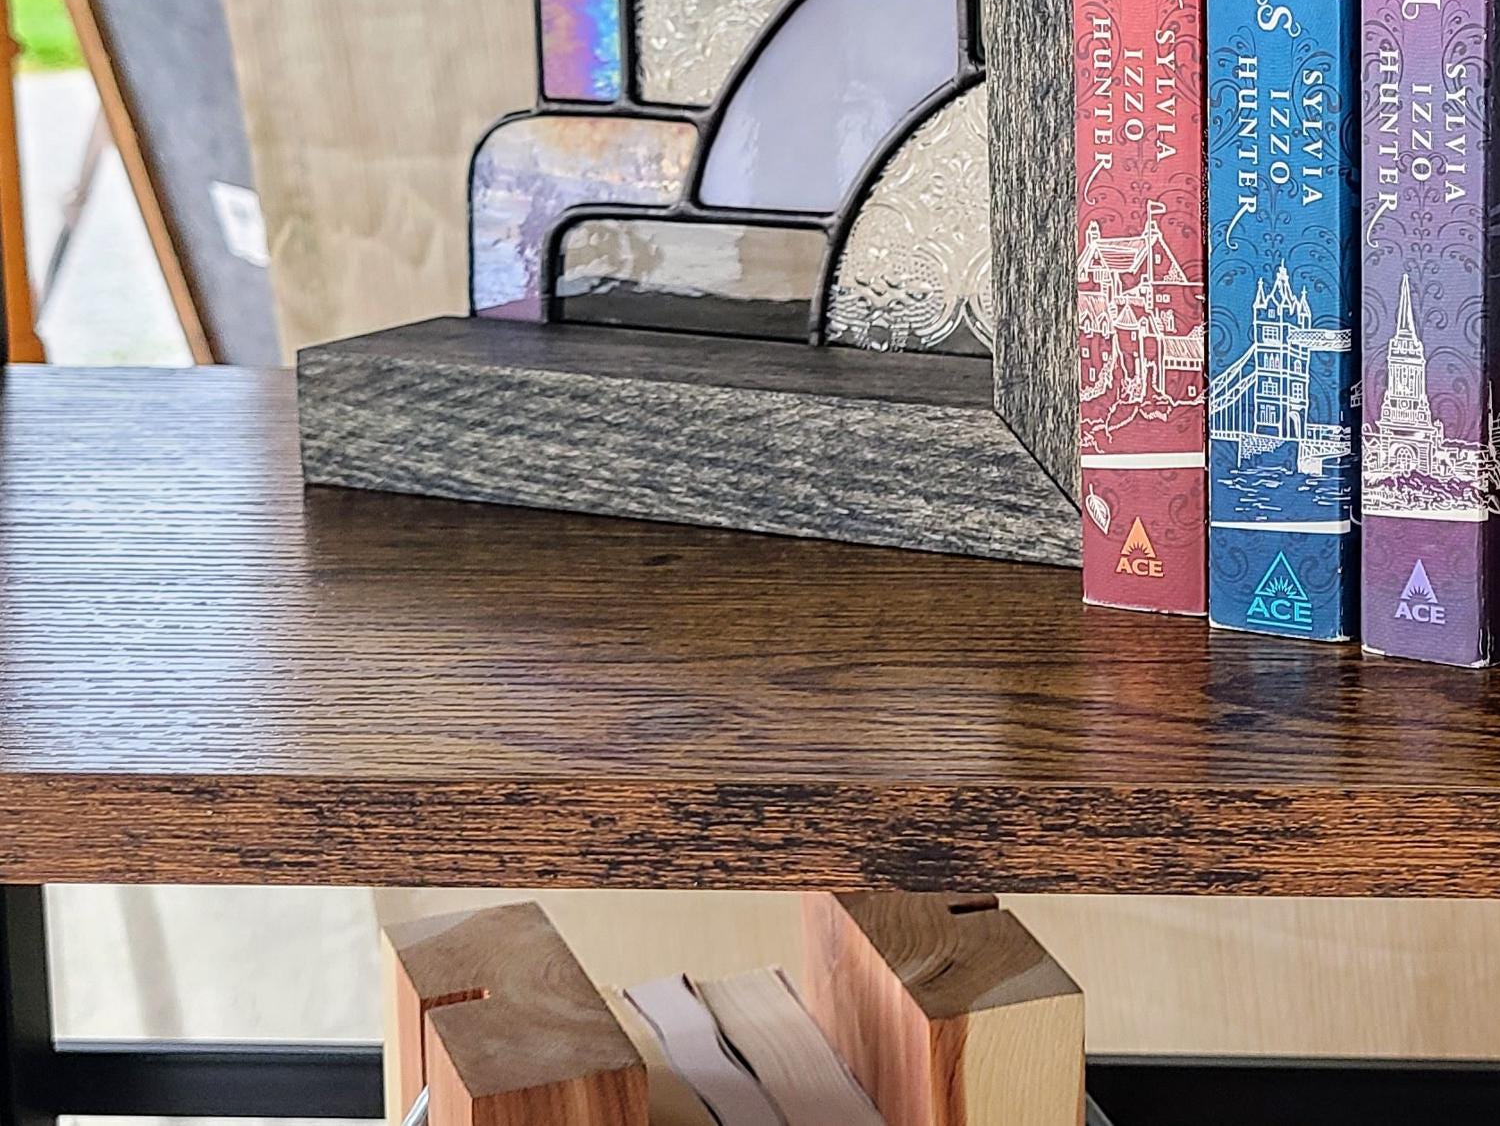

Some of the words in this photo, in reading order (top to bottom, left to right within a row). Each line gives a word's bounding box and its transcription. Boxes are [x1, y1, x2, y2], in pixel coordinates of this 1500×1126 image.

[1083, 16, 1114, 206] HUNTER
[1122, 48, 1145, 142] IZZO
[1154, 28, 1178, 163] SYLVIA
[1225, 54, 1260, 250] HUNTER
[1268, 88, 1292, 185] IZZO
[1301, 68, 1325, 206] SYLVIA
[1364, 48, 1400, 249] HUNTER
[1410, 83, 1434, 182] IZZO
[1444, 62, 1468, 204] SYLVIA
[1115, 556, 1165, 578] ACE
[1245, 596, 1313, 623] ACE
[1393, 601, 1446, 625] ACE
